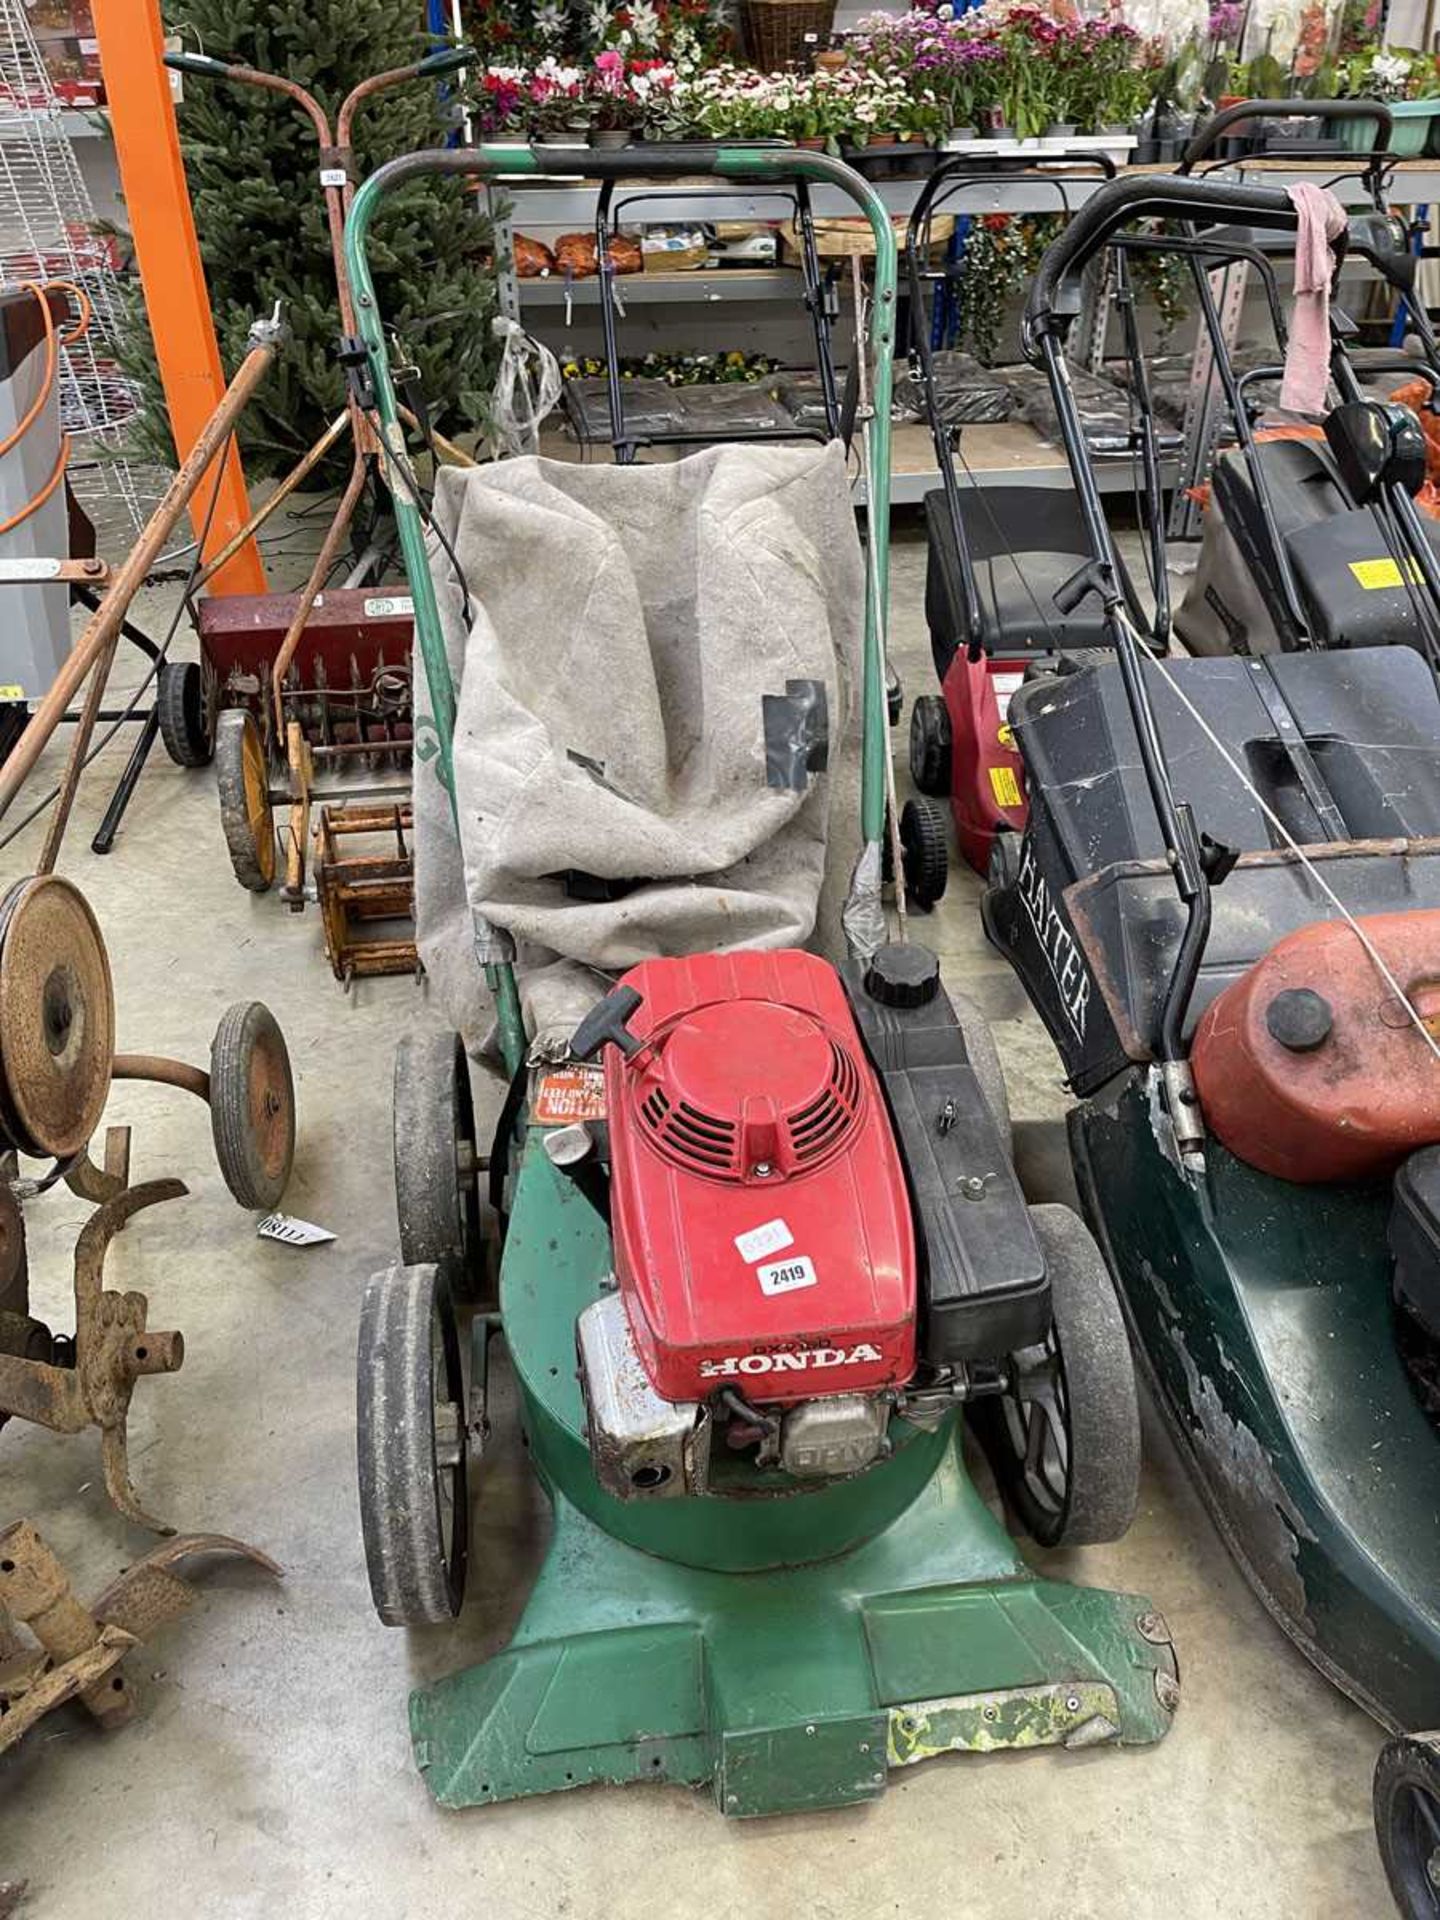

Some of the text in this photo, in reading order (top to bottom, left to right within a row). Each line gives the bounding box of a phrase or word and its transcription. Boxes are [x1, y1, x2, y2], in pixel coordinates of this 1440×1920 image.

[1018, 842, 1091, 1038] HAYTER
[545, 1098, 608, 1117] AUTION
[770, 1264, 806, 1286] 2419
[700, 1343, 882, 1377] HONDA
